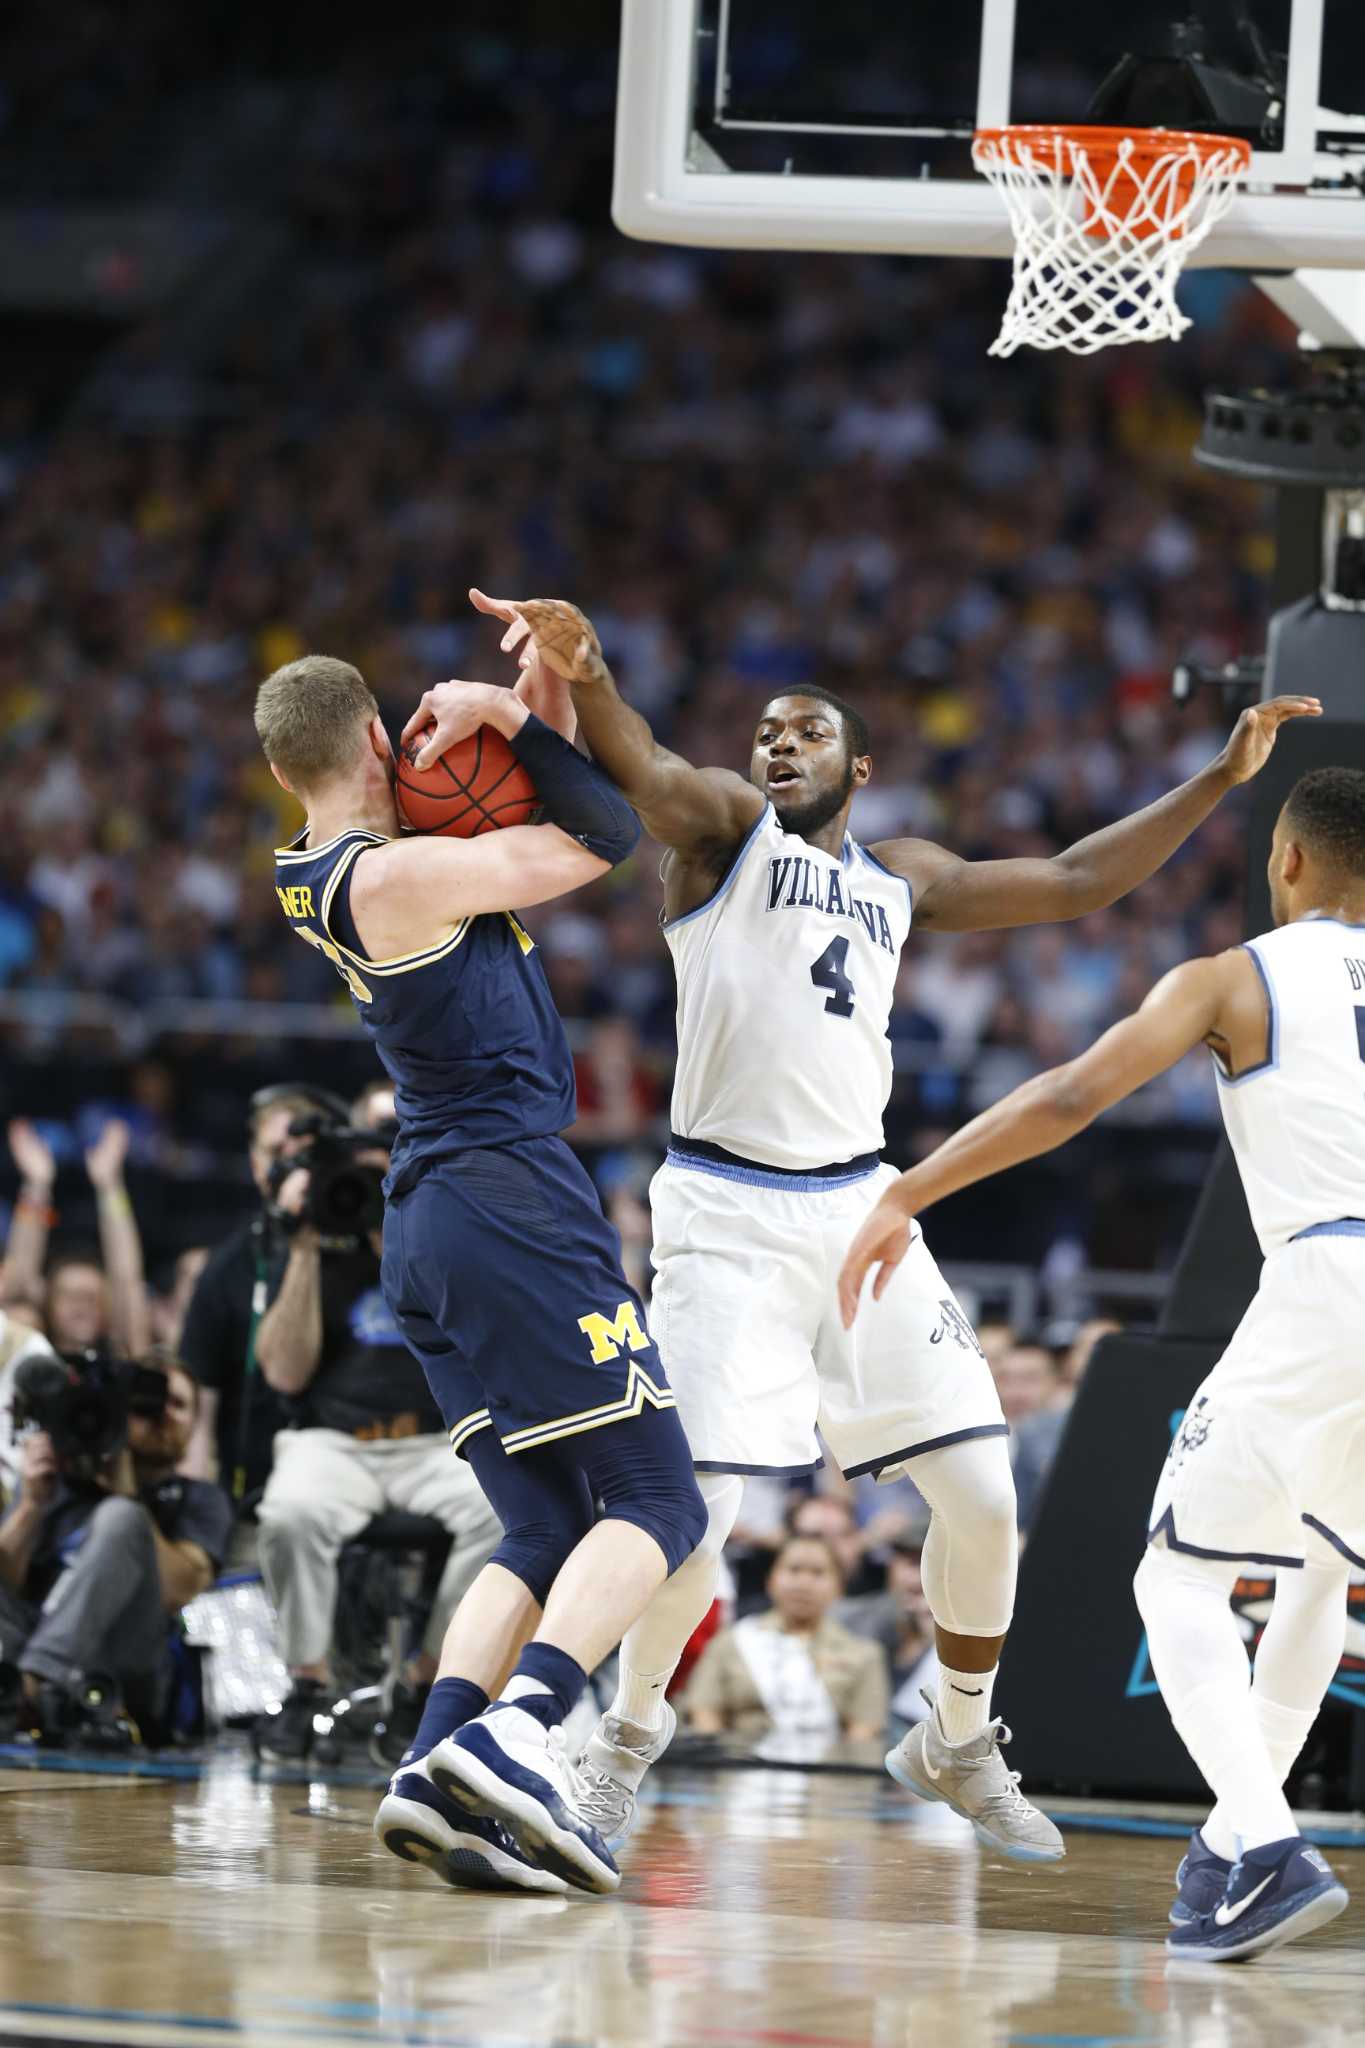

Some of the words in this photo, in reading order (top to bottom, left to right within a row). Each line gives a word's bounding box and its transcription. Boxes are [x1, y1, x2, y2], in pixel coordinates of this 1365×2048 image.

[275, 886, 316, 918] NER
[810, 935, 855, 1018] 4
[577, 1301, 651, 1365] M
